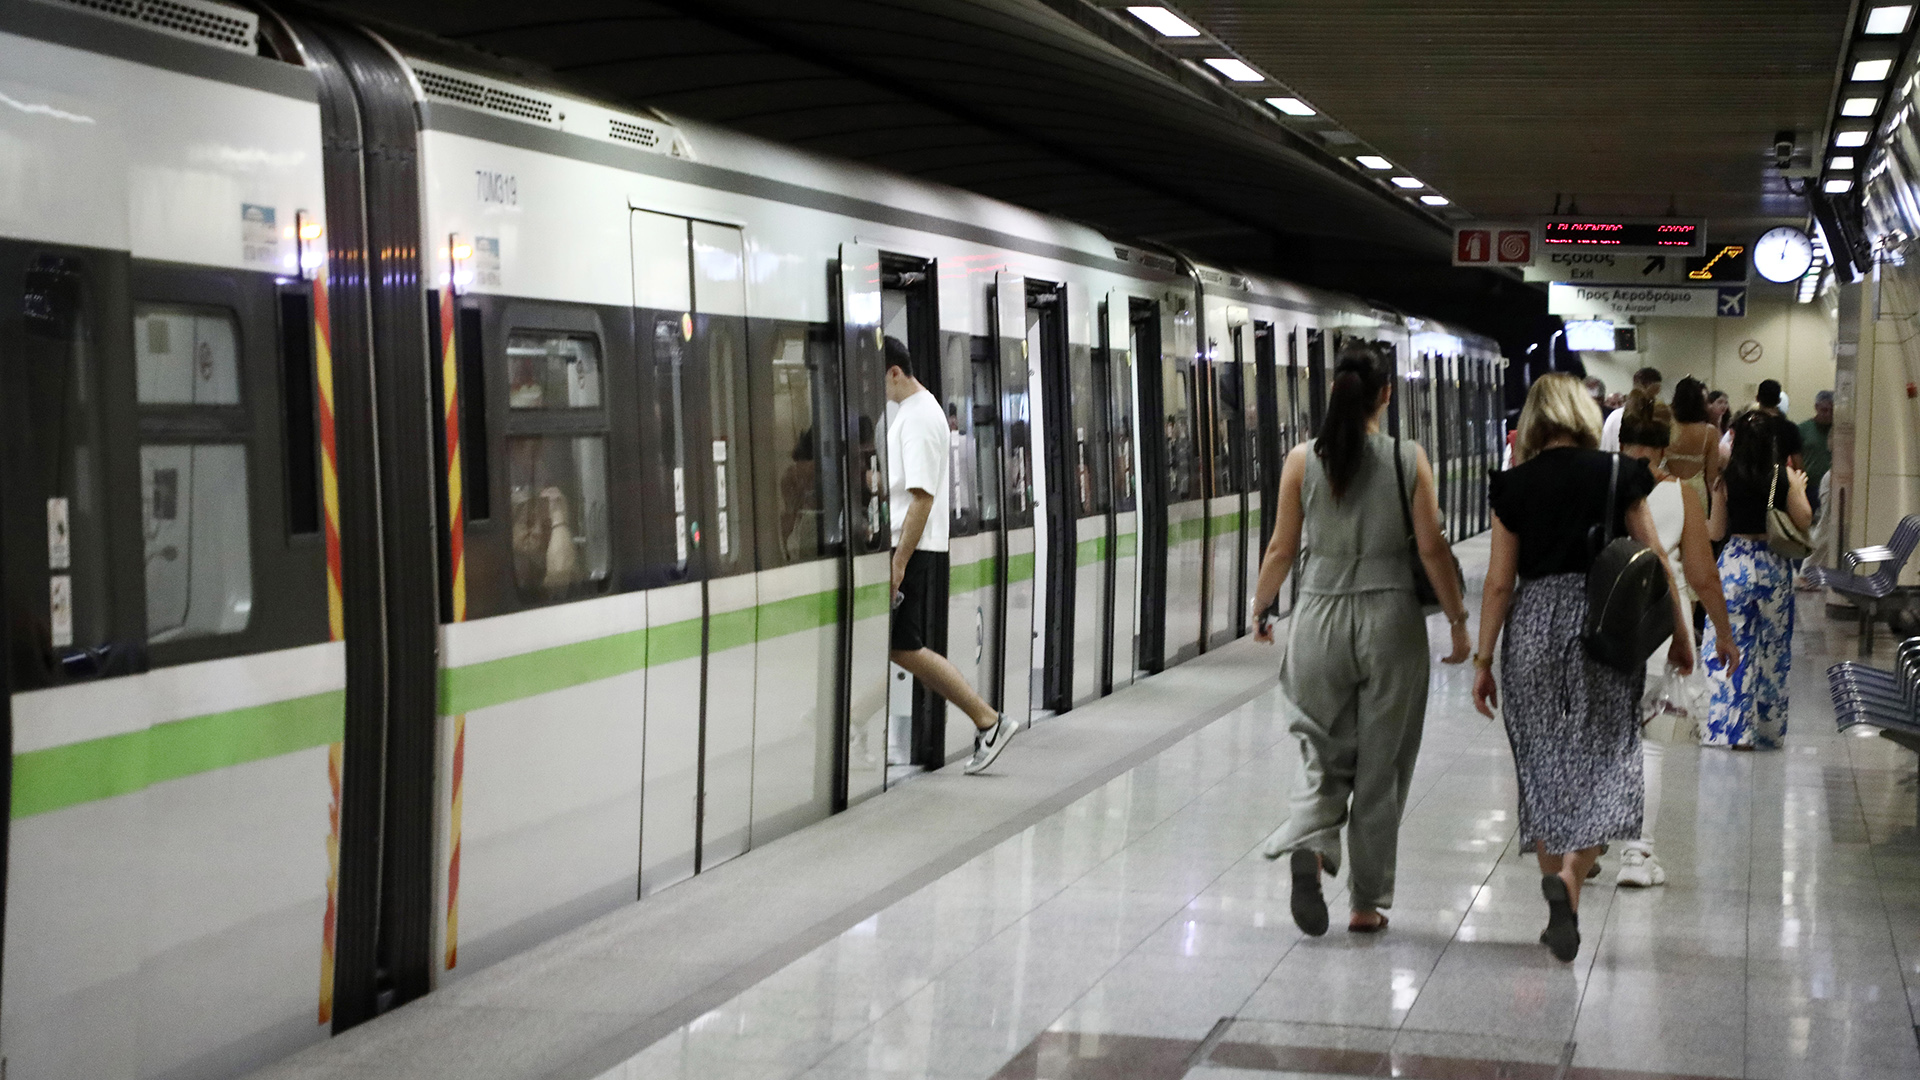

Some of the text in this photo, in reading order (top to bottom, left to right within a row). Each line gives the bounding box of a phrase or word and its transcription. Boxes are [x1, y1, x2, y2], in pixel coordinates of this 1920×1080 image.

[475, 170, 518, 206] 70M319
[1577, 288, 1692, 304] Προς Αεροδρόμιο
[1625, 304, 1656, 313] Airport
